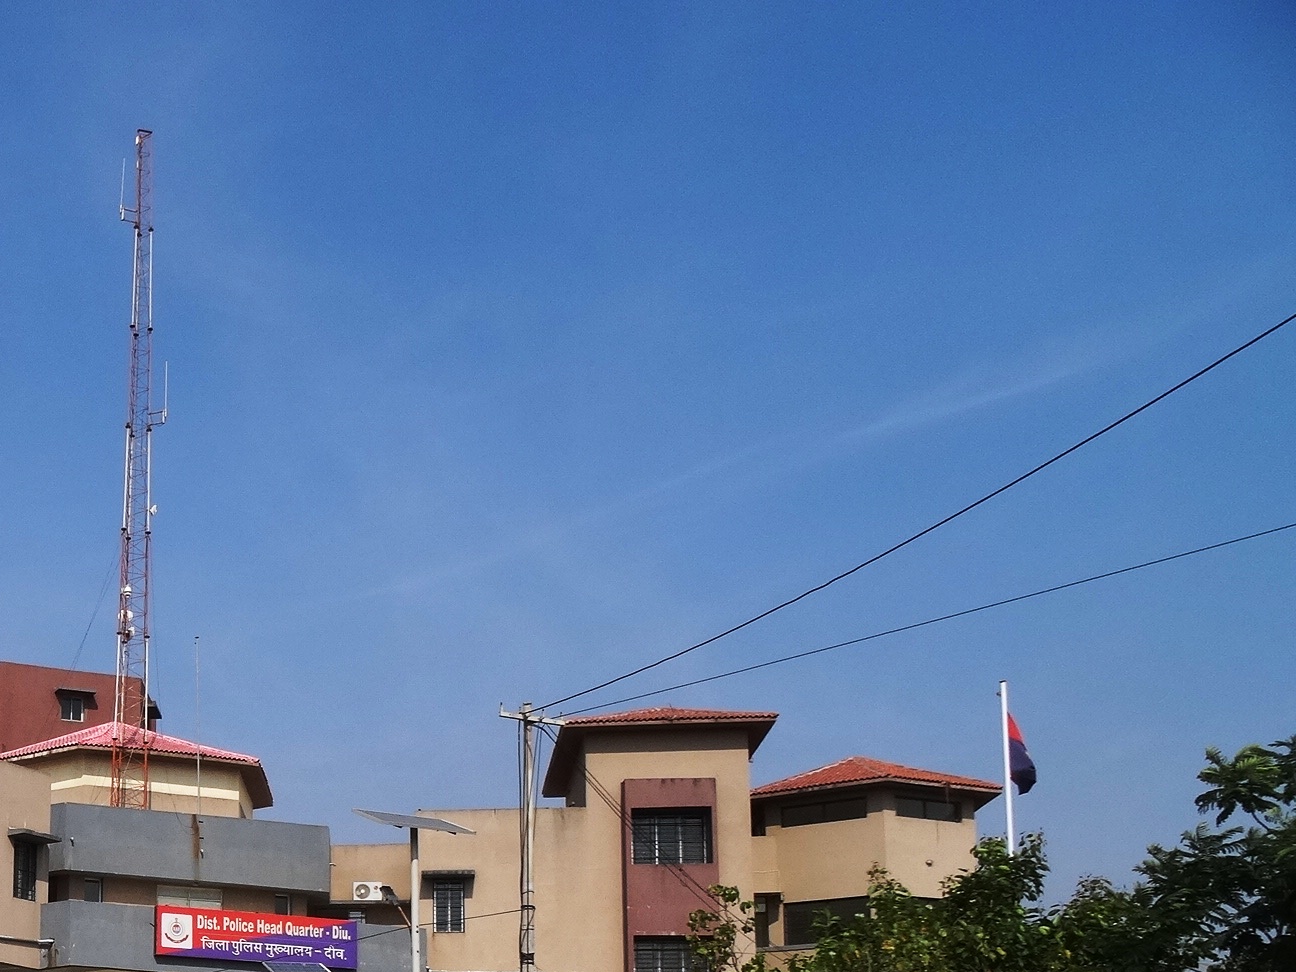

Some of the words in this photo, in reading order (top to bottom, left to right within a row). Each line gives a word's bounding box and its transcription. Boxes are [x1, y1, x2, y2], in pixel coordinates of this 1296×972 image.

[196, 915, 220, 931] Dist.
[223, 917, 254, 933] Police
[256, 919, 282, 935] Head
[285, 922, 323, 938] Quarter
[332, 926, 351, 940] Diu.
[200, 936, 229, 951] जिला
[232, 939, 263, 956] पुलिस
[264, 942, 312, 957] मुख्यालय
[324, 944, 347, 961] दीव.
